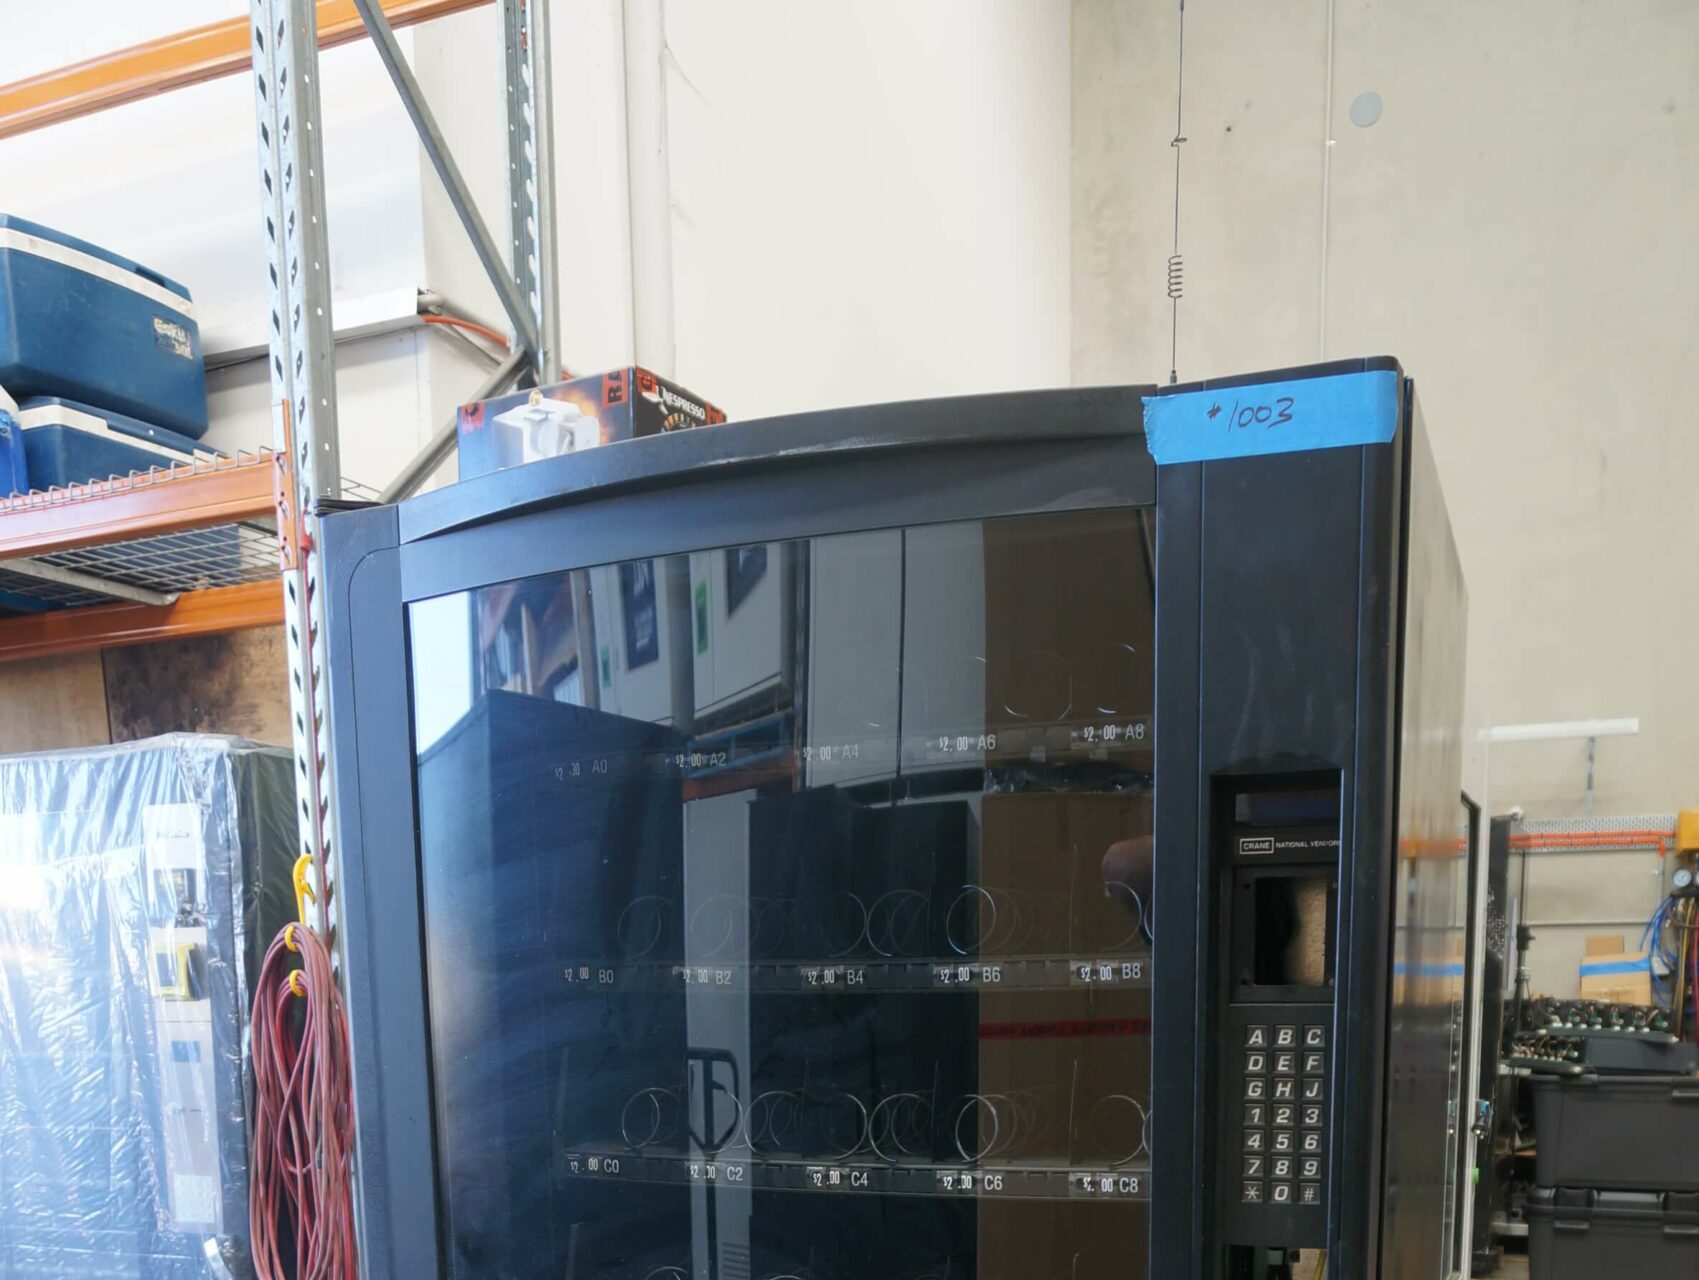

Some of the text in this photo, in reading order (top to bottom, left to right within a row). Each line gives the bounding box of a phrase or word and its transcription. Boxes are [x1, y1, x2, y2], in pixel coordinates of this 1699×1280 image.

[663, 386, 706, 419] NESPRESSO
[1084, 723, 1144, 742] $2.00 A8
[940, 734, 996, 752] $2.00 A6
[710, 752, 726, 767] A2
[804, 744, 859, 761] $2.00 A4
[592, 759, 607, 774] A0
[1244, 842, 1270, 850] CRANE
[599, 969, 614, 984] B0
[683, 969, 732, 985] $2.00 B2
[808, 970, 864, 985] $2.00 B4
[940, 966, 1001, 984] $2.00 B6
[1081, 962, 1141, 982] $2.00 B8
[1248, 1028, 1321, 1044] A B C
[1248, 1056, 1320, 1071] D E F
[1248, 1081, 1319, 1097] G H J
[1251, 1108, 1319, 1124] 1 2 3
[1248, 1134, 1318, 1150] 4 5 6
[570, 1158, 620, 1174] $2.00 C0
[726, 1166, 743, 1182] C2
[1248, 1159, 1318, 1175] 7 8 9
[813, 1170, 868, 1187] $2.00 C4
[943, 1174, 1003, 1191] $2.00 C6
[1119, 1177, 1138, 1193] C8
